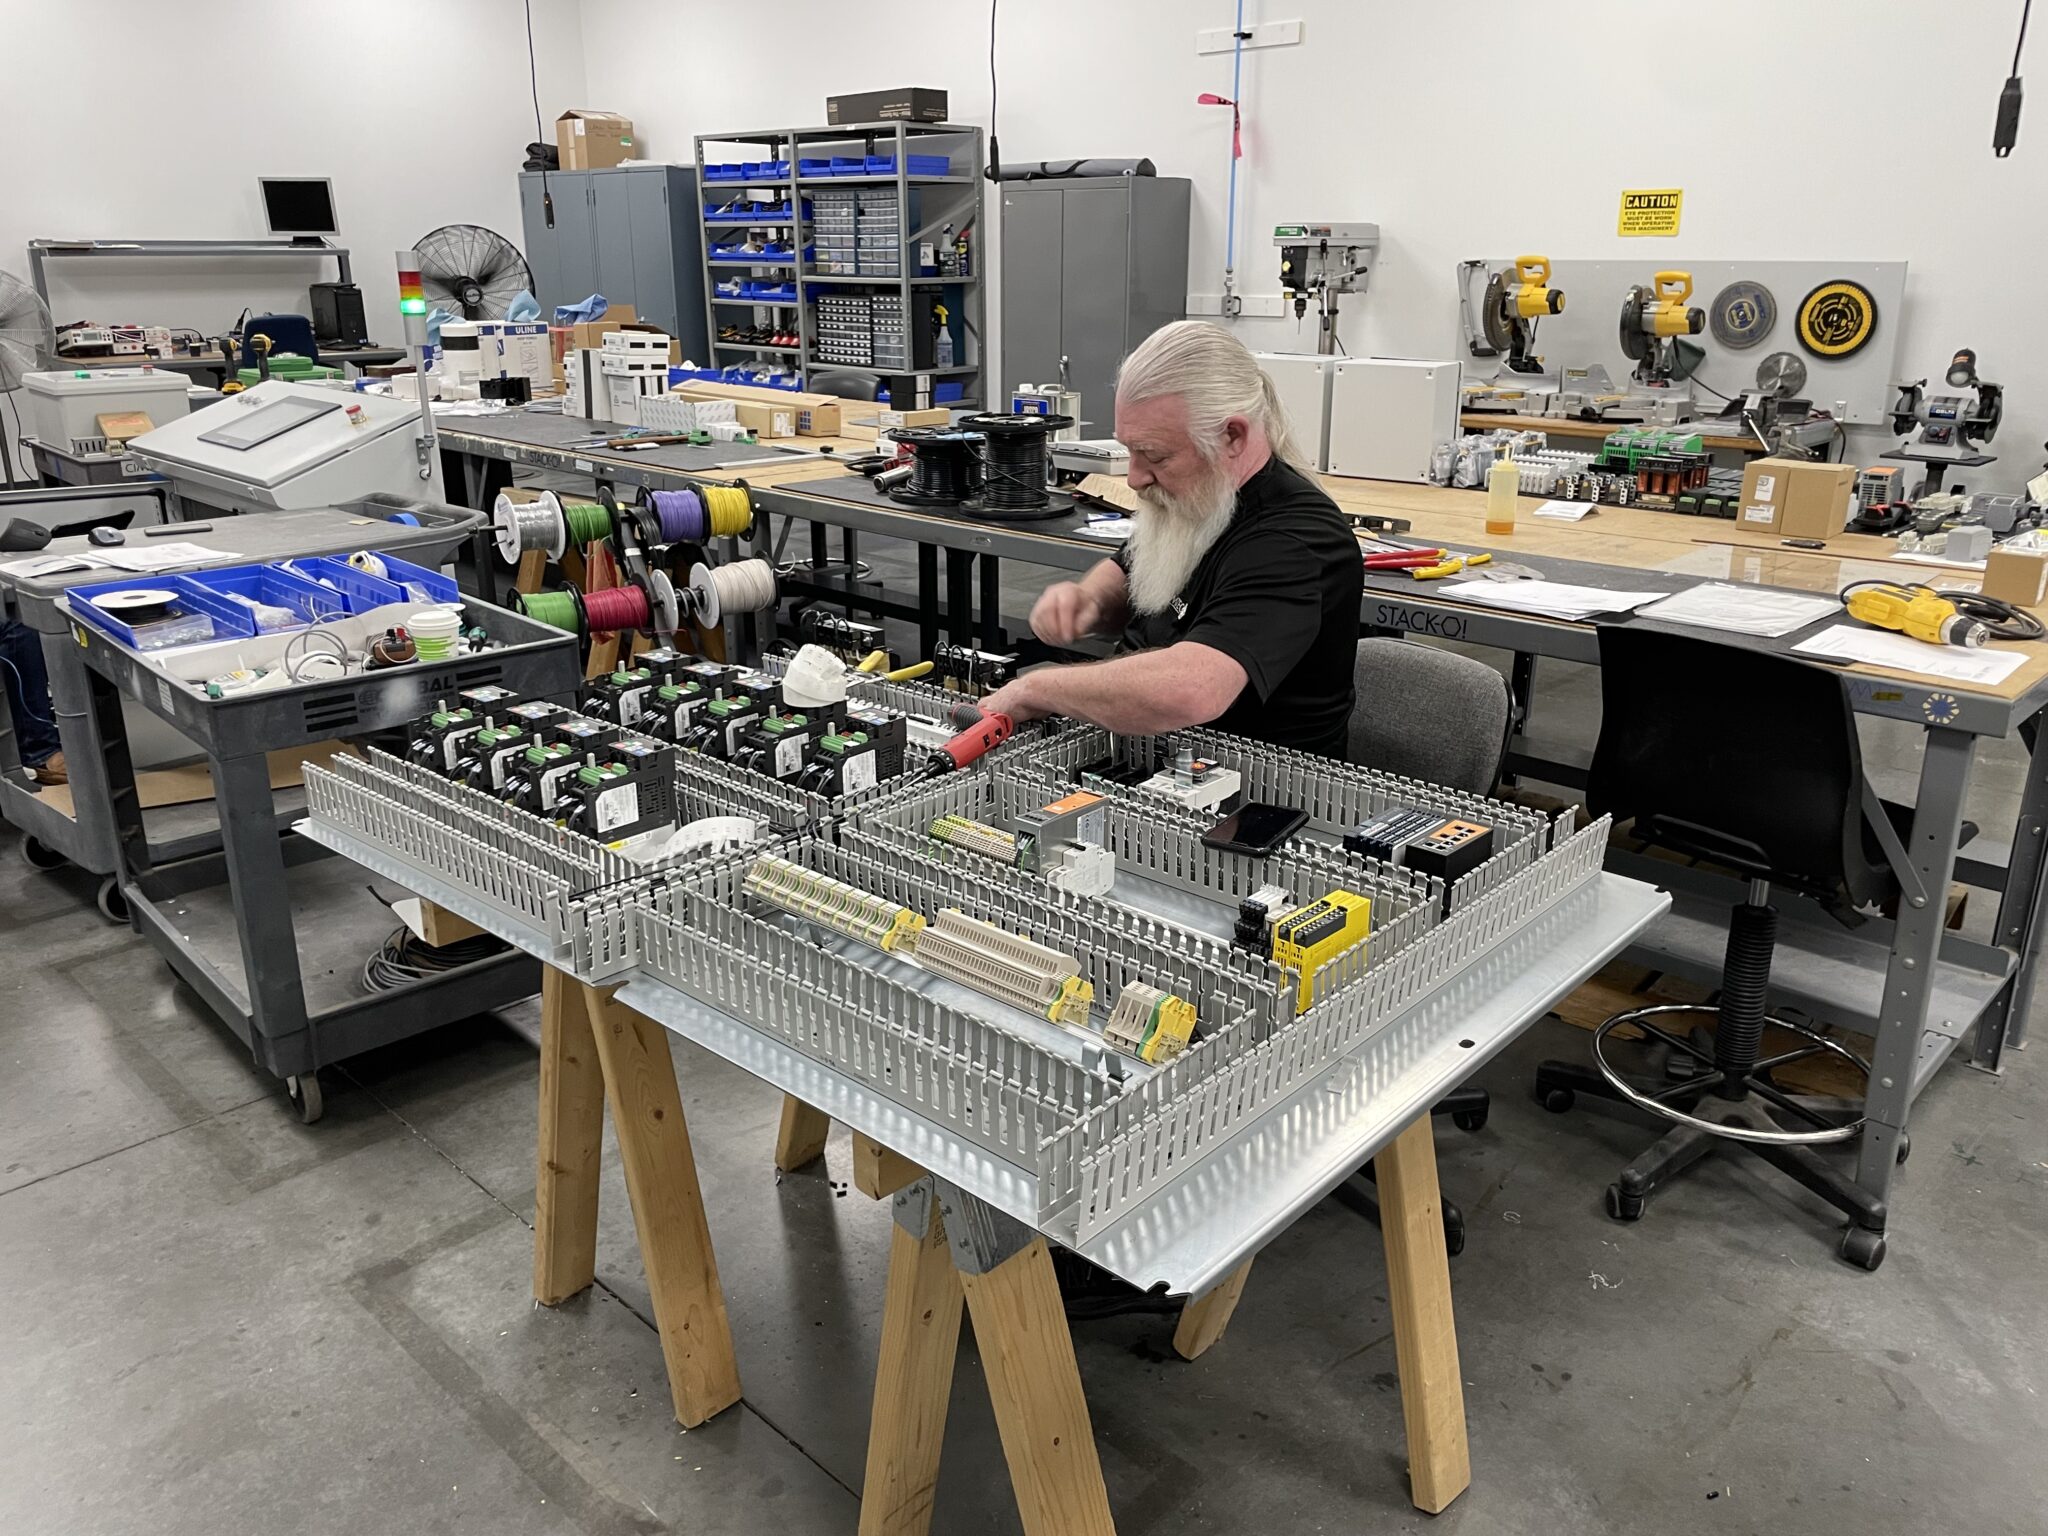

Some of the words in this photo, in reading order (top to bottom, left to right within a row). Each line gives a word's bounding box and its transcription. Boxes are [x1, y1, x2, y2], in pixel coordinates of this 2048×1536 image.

[1626, 196, 1677, 207] CAUTION
[515, 326, 537, 334] ULINE
[1377, 604, 1467, 639] STACK-O!
